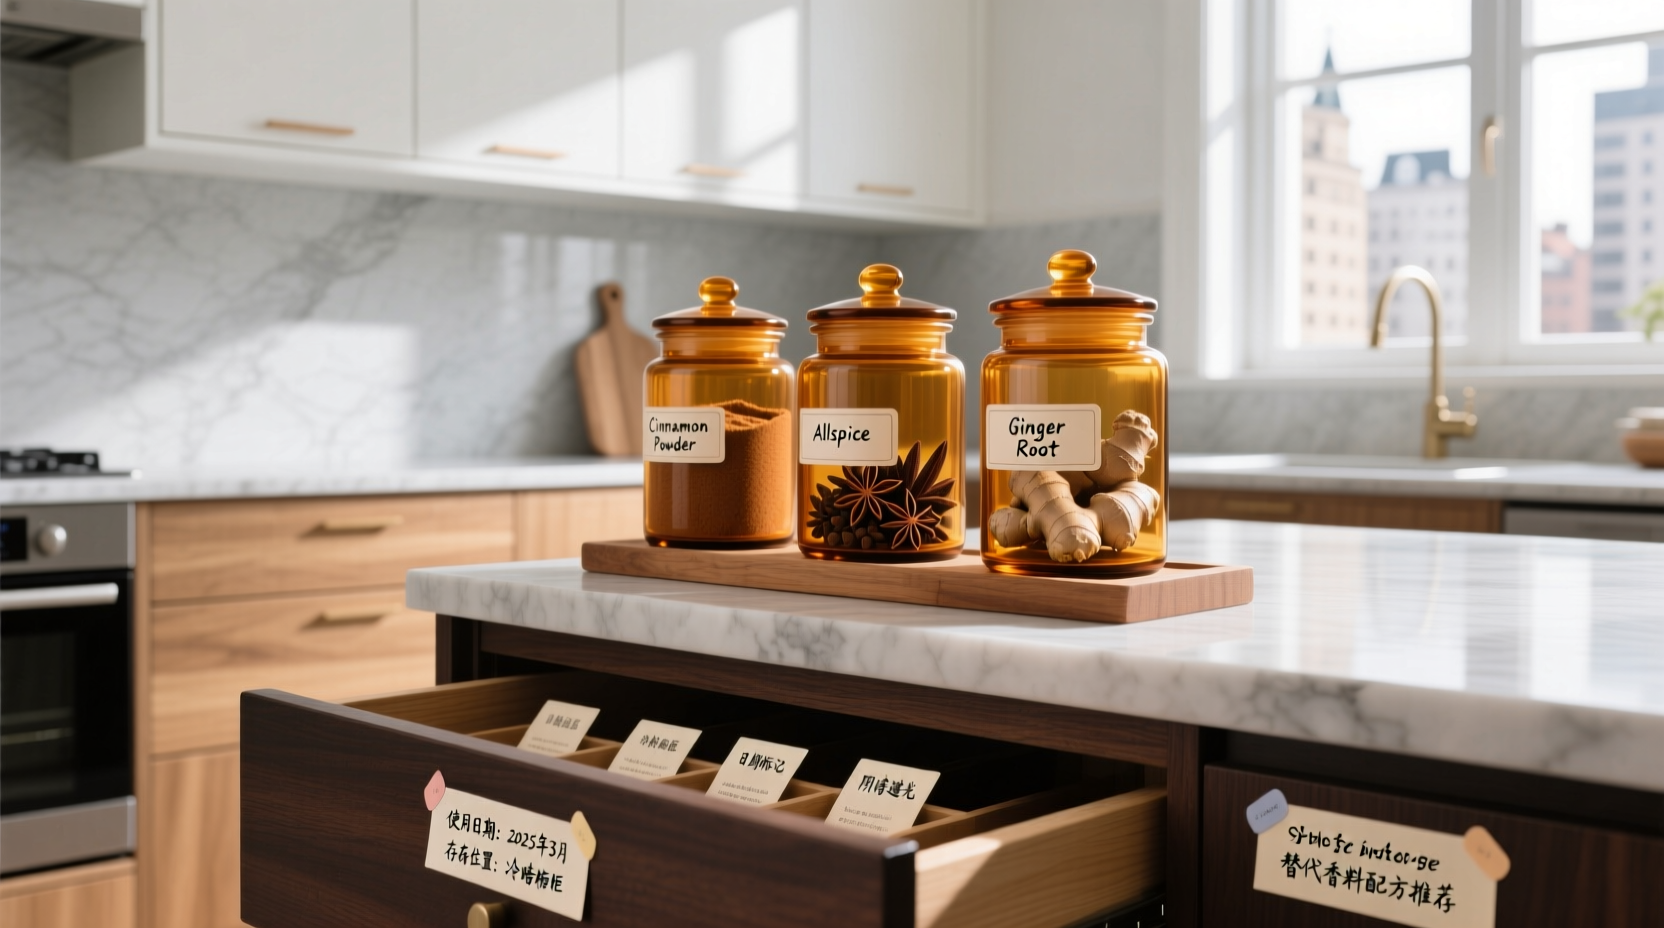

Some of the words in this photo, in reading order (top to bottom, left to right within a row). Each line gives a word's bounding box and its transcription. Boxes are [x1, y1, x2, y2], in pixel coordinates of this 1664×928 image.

[649, 416, 708, 433] Cinnamon
[1009, 416, 1066, 442] Ginger
[654, 435, 696, 452] Powder
[813, 423, 871, 448] Allspice
[1016, 439, 1060, 457] Root
[1281, 851, 1456, 913] 替代香料配方推荐
